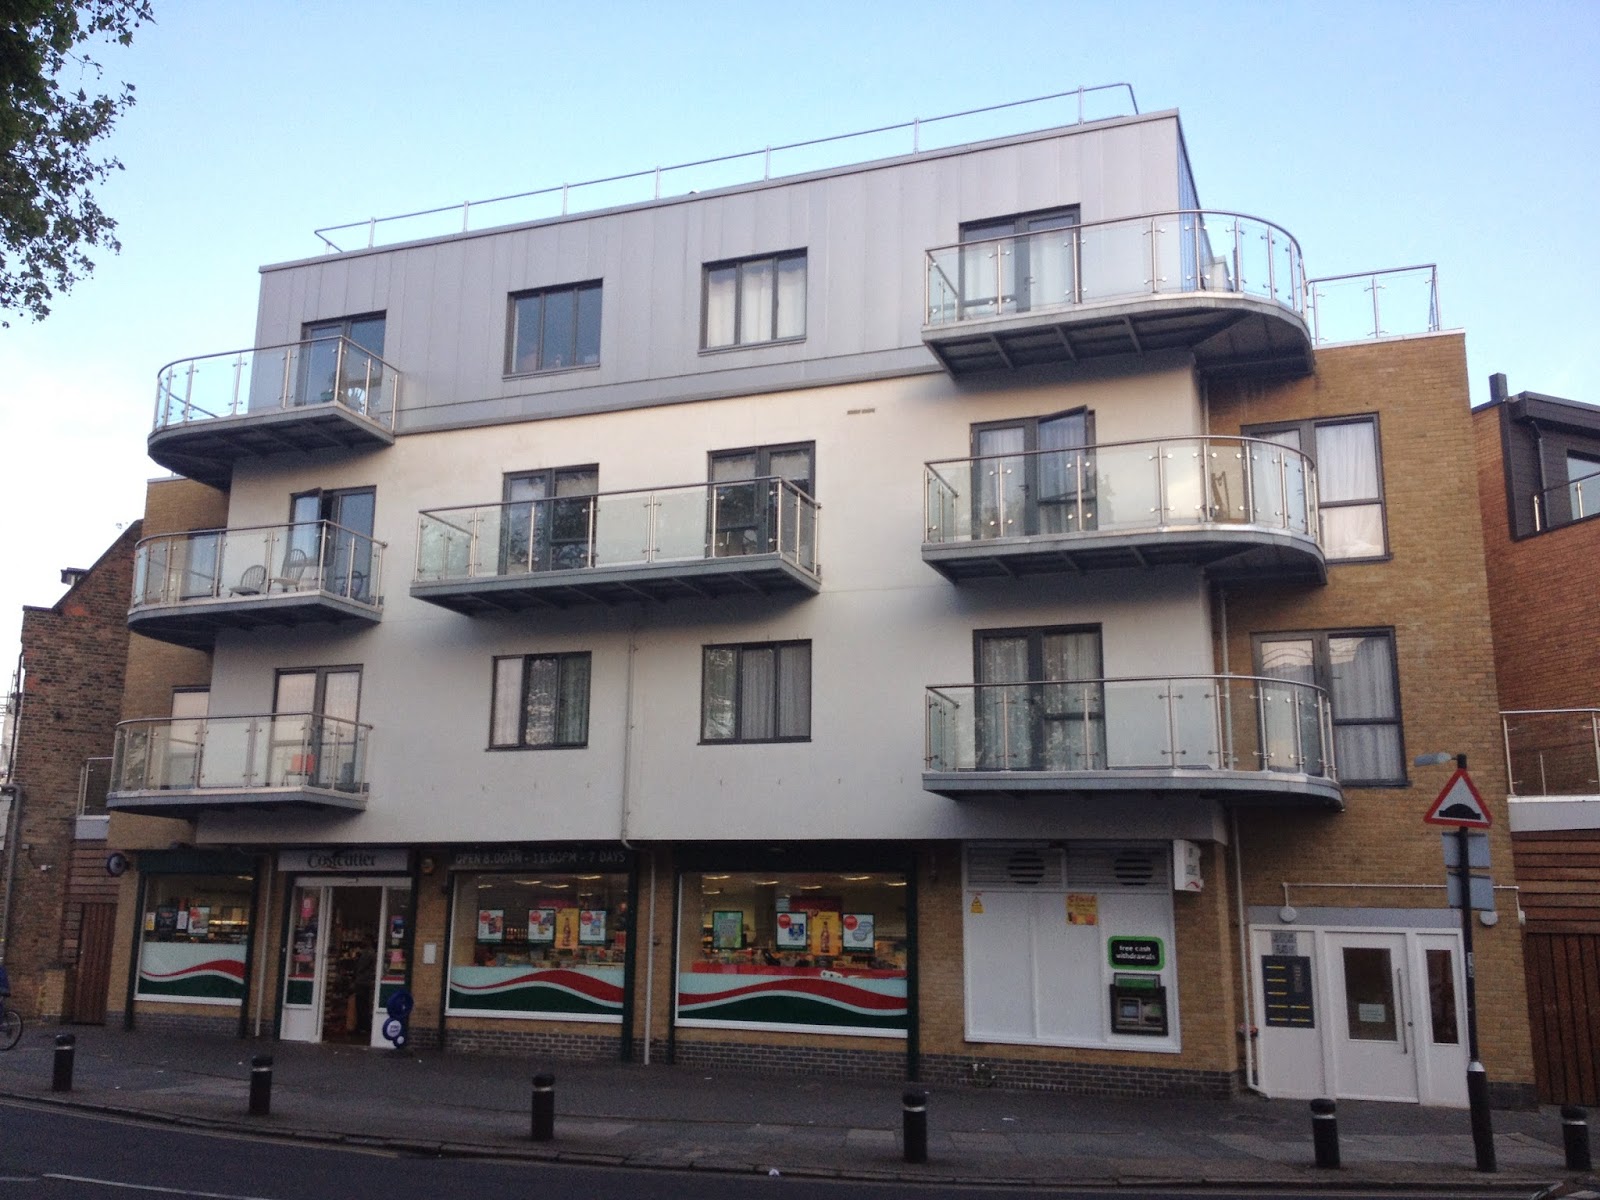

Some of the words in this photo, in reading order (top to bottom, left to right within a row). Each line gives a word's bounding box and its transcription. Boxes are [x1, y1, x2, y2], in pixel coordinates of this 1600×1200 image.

[307, 852, 376, 869] Costcutter
[455, 853, 481, 865] OPEN
[483, 852, 523, 865] 8.00AM
[600, 850, 626, 863] DAYS
[1115, 952, 1156, 960] withdrawals
